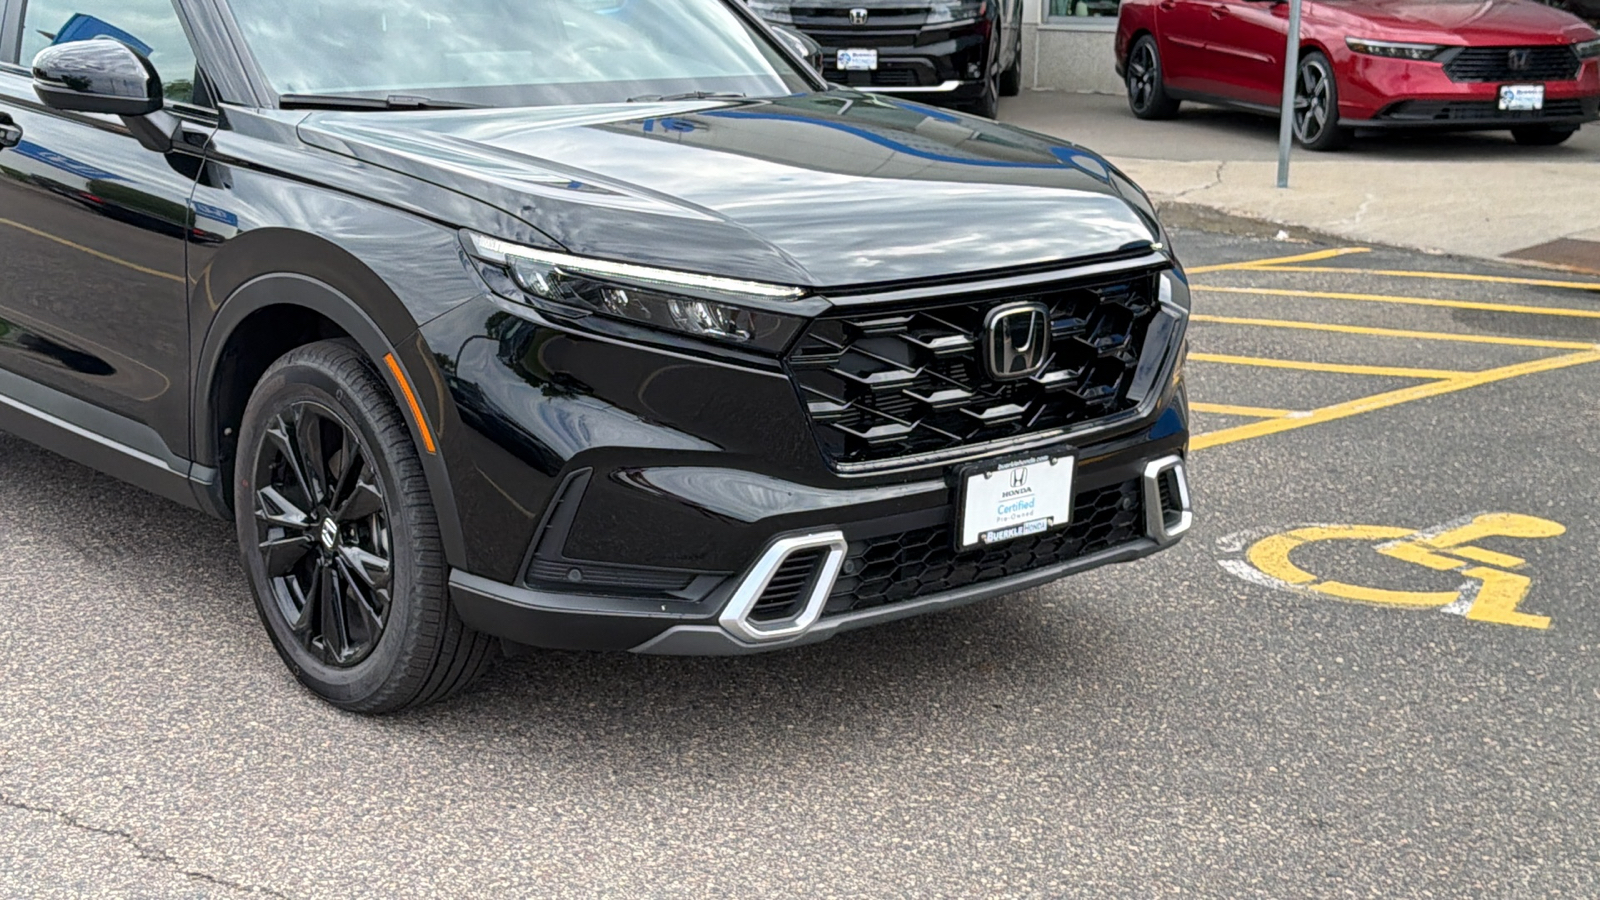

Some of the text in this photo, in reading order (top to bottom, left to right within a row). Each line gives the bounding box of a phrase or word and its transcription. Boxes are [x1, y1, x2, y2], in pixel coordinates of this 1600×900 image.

[1002, 487, 1032, 498] HONDA
[997, 498, 1035, 515] Certified
[996, 511, 1034, 523] Pre-Owned
[986, 526, 1024, 543] BUERKLE
